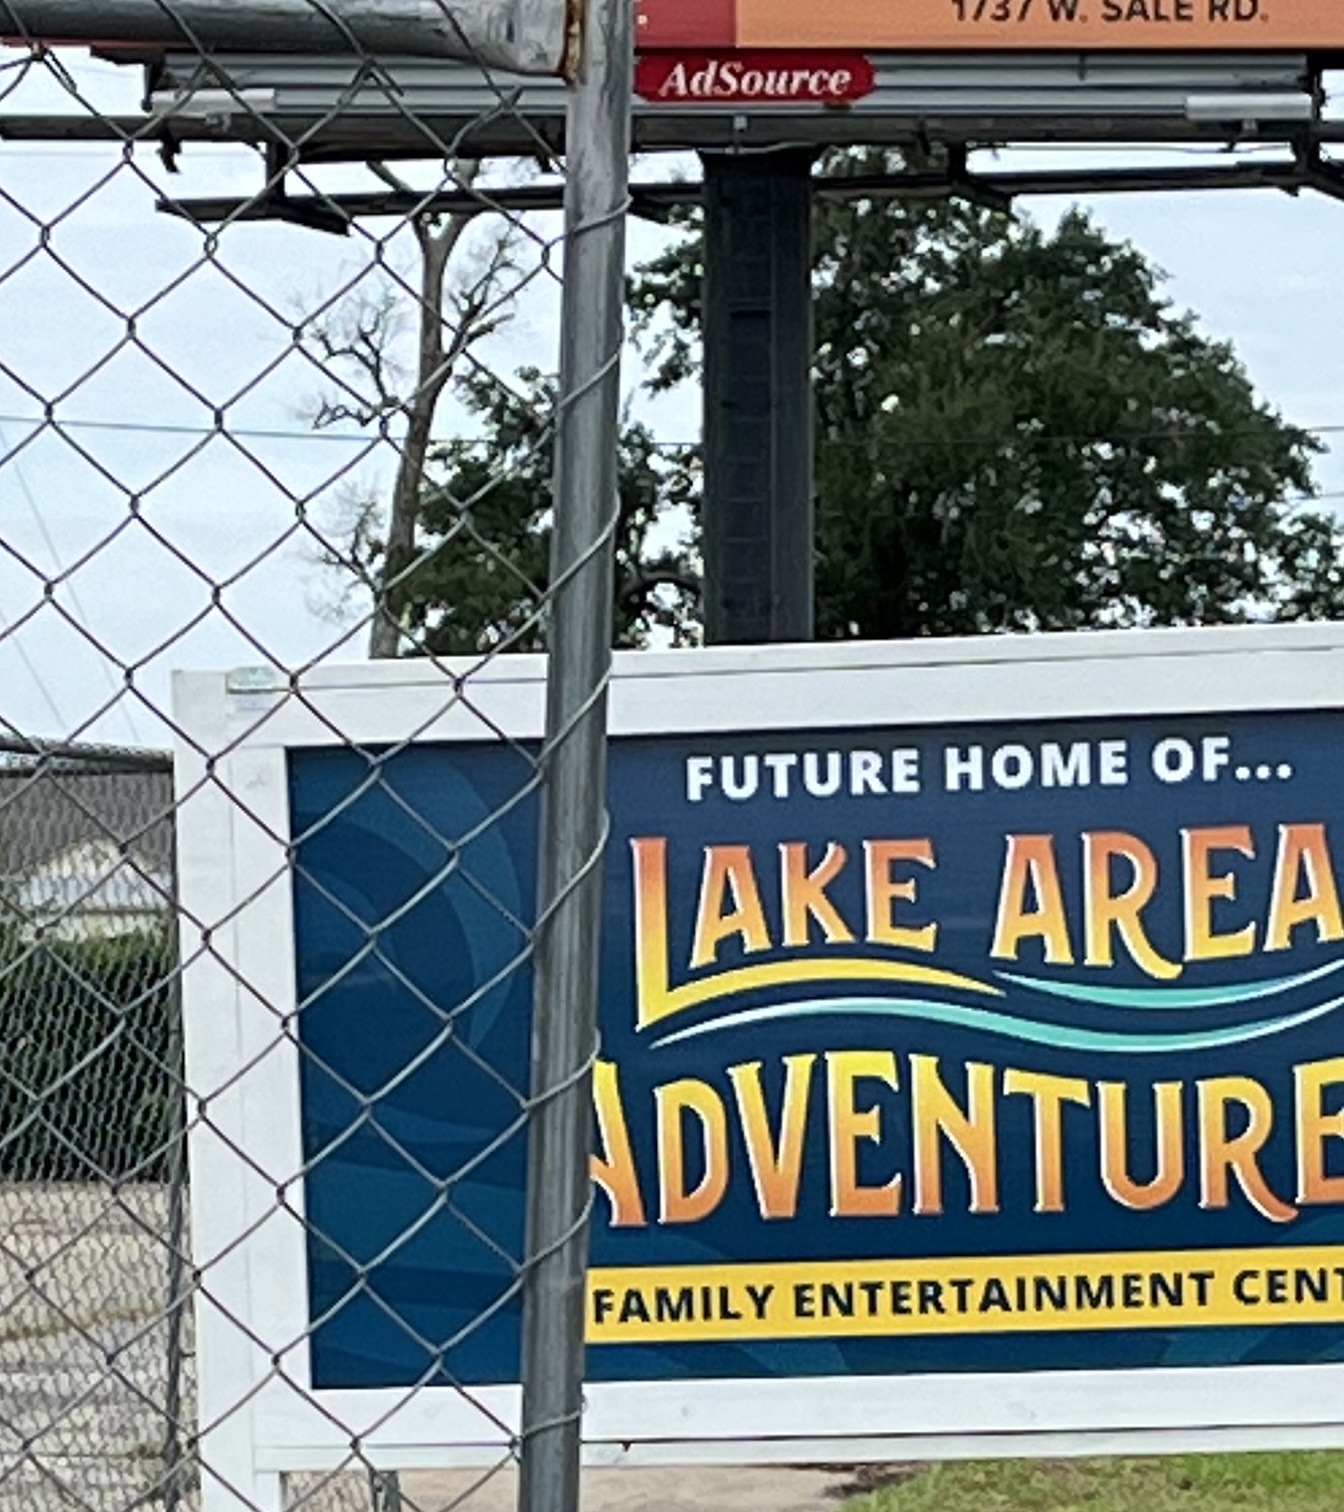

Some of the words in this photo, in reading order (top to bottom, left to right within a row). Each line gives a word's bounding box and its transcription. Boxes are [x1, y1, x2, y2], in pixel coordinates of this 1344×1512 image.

[951, 0, 1033, 22] 1737
[1046, 0, 1088, 23] W.
[1100, 0, 1194, 22] SALE
[1208, 0, 1269, 23] RD.
[658, 60, 852, 97] AdSource
[686, 748, 920, 801] FUTURE
[944, 742, 1129, 792] HOME
[1152, 736, 1292, 784] OF...
[630, 837, 941, 1033] LAKE
[592, 1284, 775, 1324] FAMILY
[793, 1272, 1216, 1319] ENTERTAINMENT
